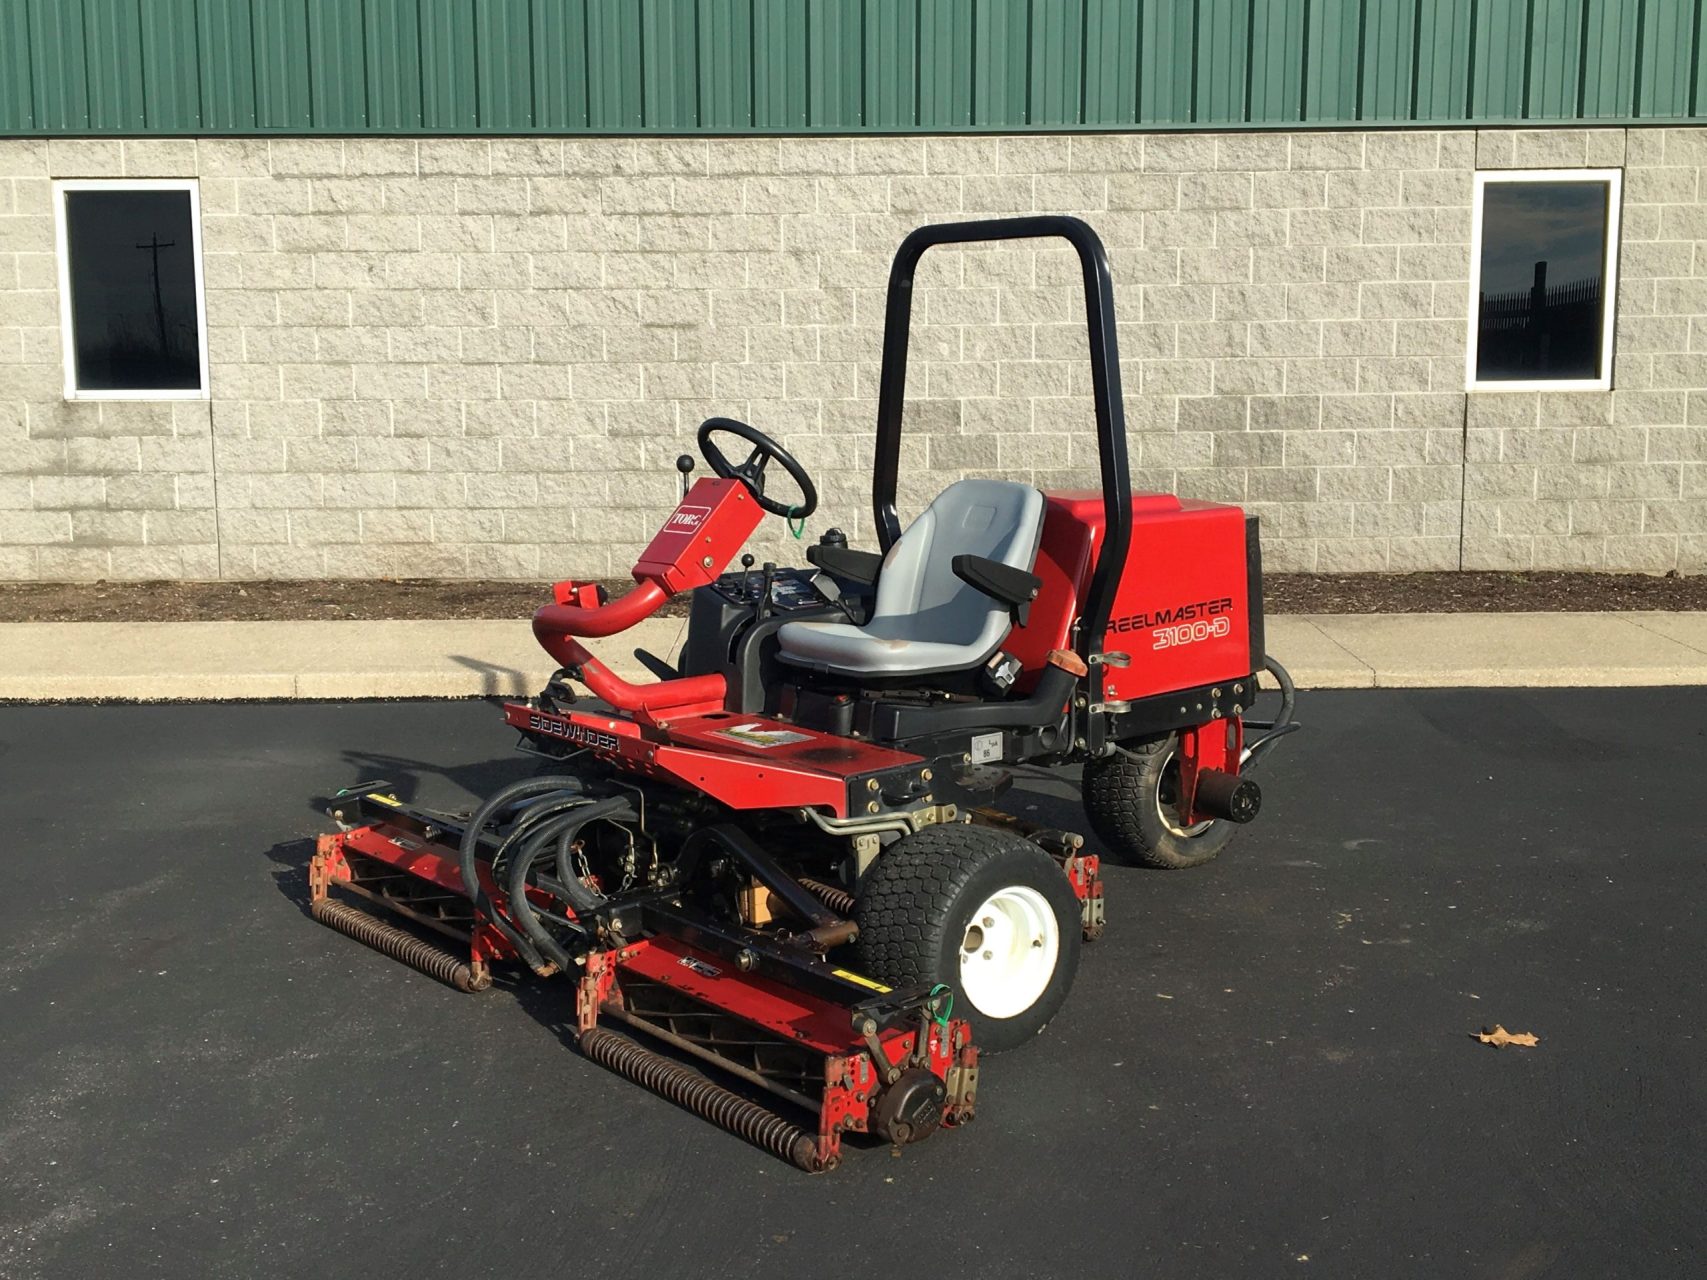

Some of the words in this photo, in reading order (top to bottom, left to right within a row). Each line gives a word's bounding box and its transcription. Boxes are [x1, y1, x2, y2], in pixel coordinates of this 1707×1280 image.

[1105, 598, 1233, 634] REELMASTER
[1153, 616, 1230, 650] 3100-D
[530, 714, 621, 753] SIDEWINDER
